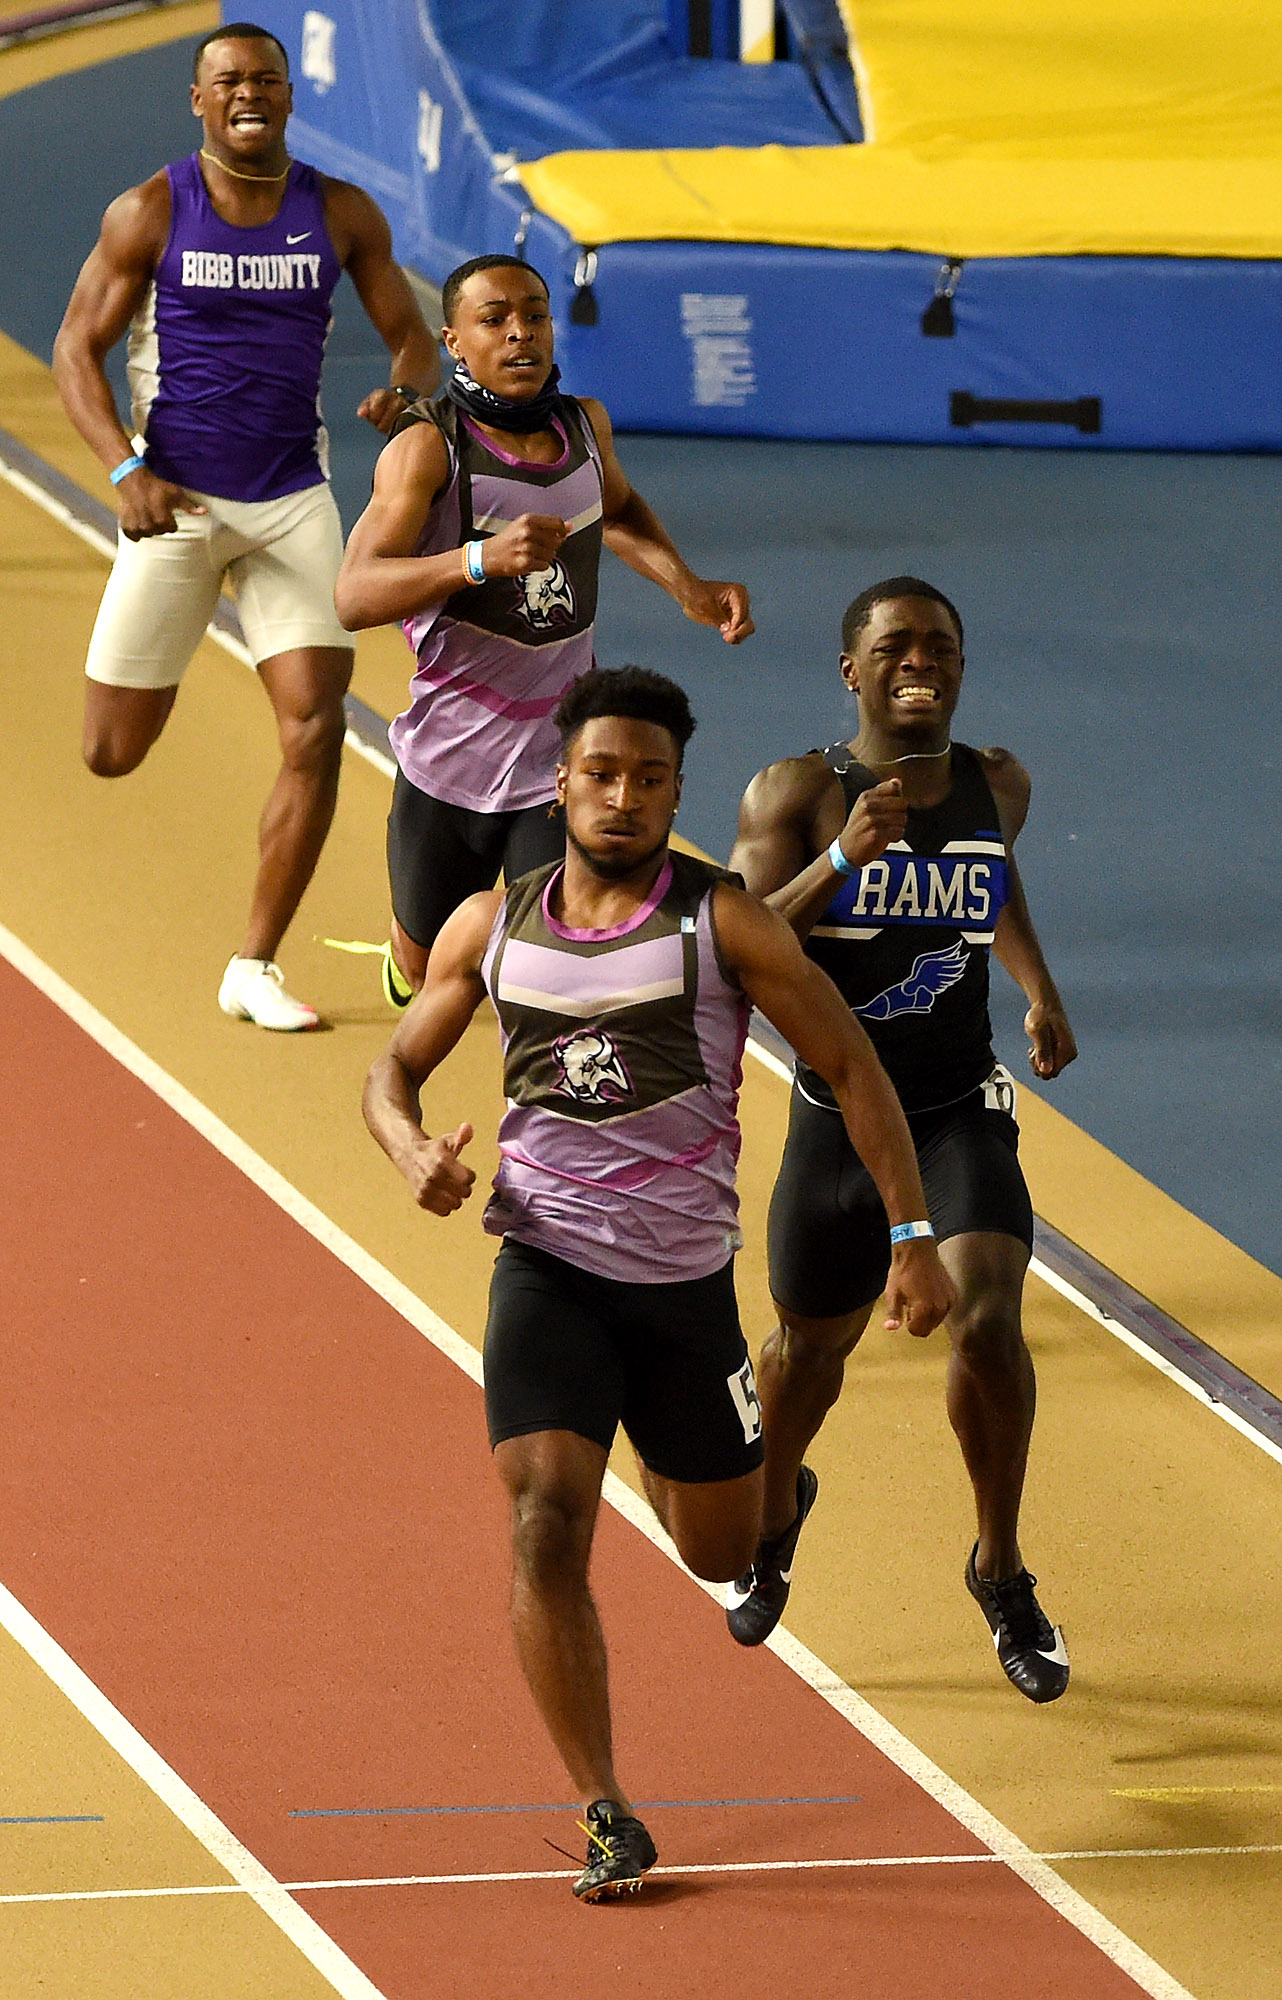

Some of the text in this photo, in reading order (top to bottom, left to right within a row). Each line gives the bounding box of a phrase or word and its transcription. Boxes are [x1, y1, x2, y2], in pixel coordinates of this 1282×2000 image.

[182, 251, 321, 289] BIBB COUNTY
[852, 860, 991, 920] RAMS
[739, 1366, 760, 1434] 5
